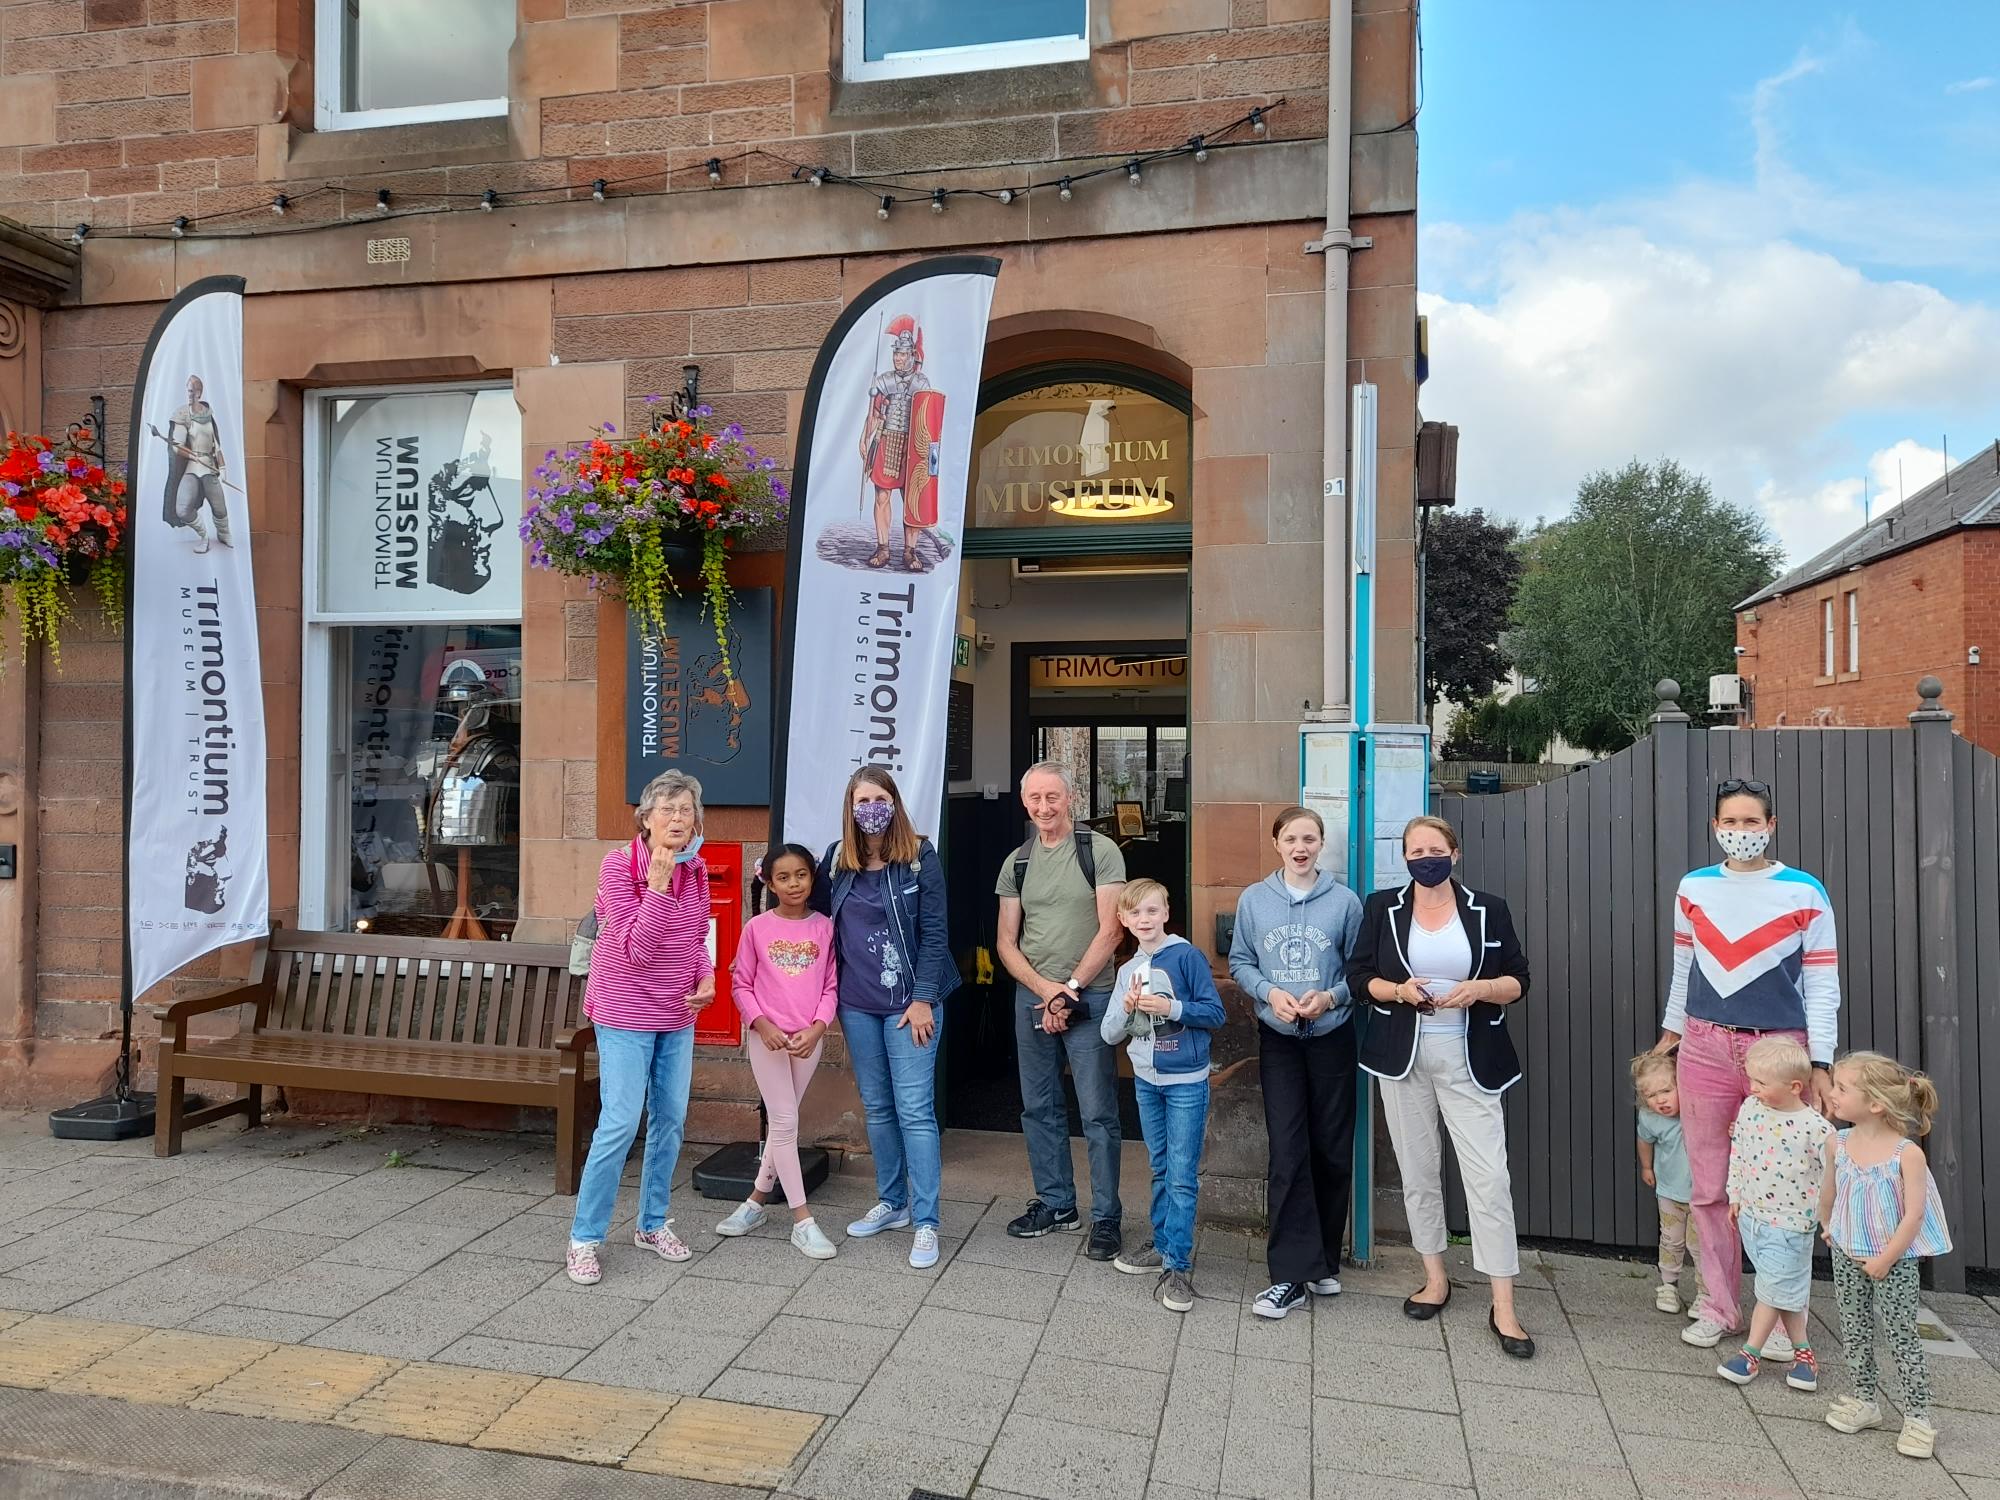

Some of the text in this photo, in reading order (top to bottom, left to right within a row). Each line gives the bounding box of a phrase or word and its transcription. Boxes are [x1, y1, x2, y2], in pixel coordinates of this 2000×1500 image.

[375, 437, 392, 589] TRIMONTIUM
[395, 436, 419, 589] MUSEUM
[982, 476, 1169, 513] MUSEUM
[1324, 479, 1343, 494] 91
[180, 587, 197, 692] MUSEUM
[196, 578, 236, 815] Trimontium
[642, 635, 658, 757] TRIMONTIUM
[660, 636, 681, 759] MUSEUM
[853, 591, 872, 706] MUSEUM
[867, 583, 915, 771] Trimonti
[1040, 656, 1186, 678] TRIMONTIU
[187, 737, 200, 815] TRUST
